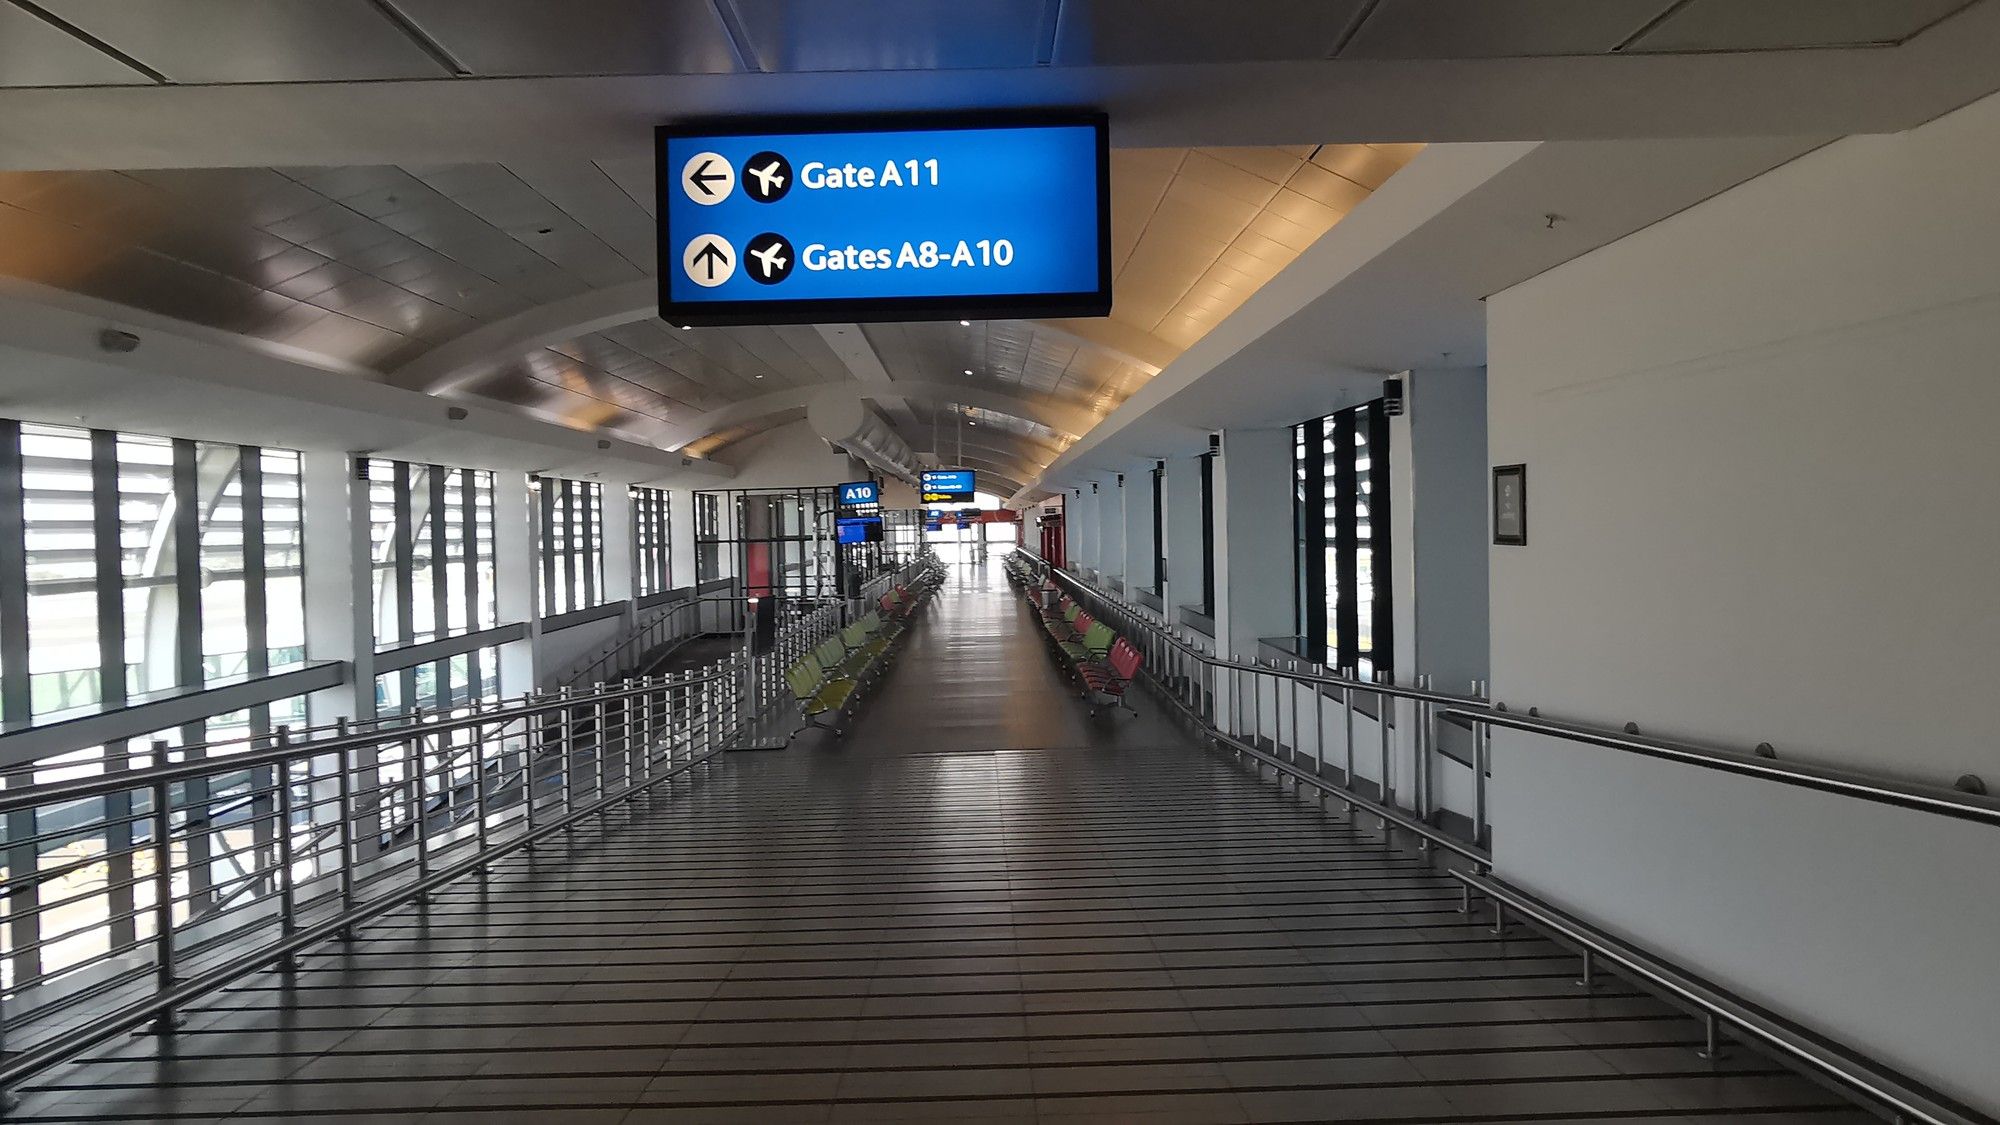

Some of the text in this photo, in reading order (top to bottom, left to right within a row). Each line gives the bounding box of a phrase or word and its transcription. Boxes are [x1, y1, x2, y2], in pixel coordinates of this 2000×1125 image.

[800, 159, 939, 189] Gate A11
[802, 239, 1014, 271] Gates A8-A10
[845, 487, 872, 500] A10
